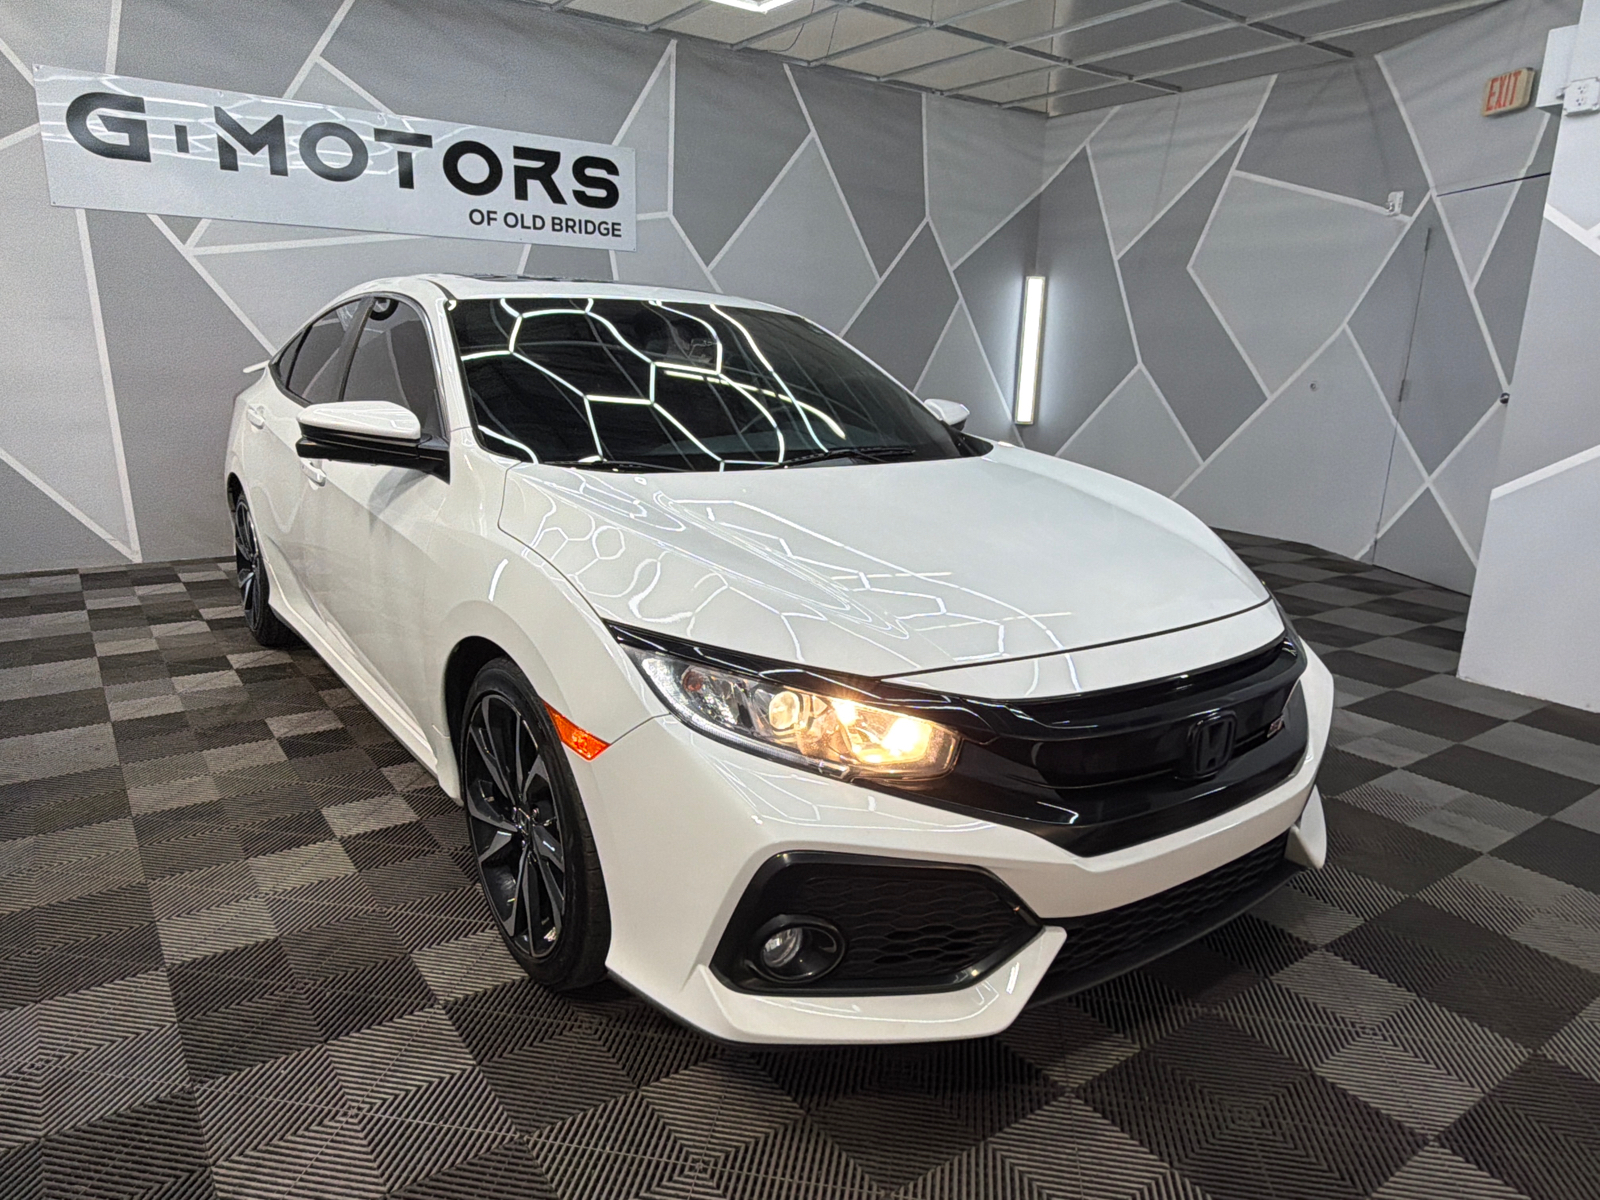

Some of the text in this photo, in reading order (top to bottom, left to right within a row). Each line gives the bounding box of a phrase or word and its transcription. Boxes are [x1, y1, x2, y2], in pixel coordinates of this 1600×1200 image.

[1485, 69, 1522, 112] EXIT
[468, 208, 622, 238] OF OLD BRIDGE
